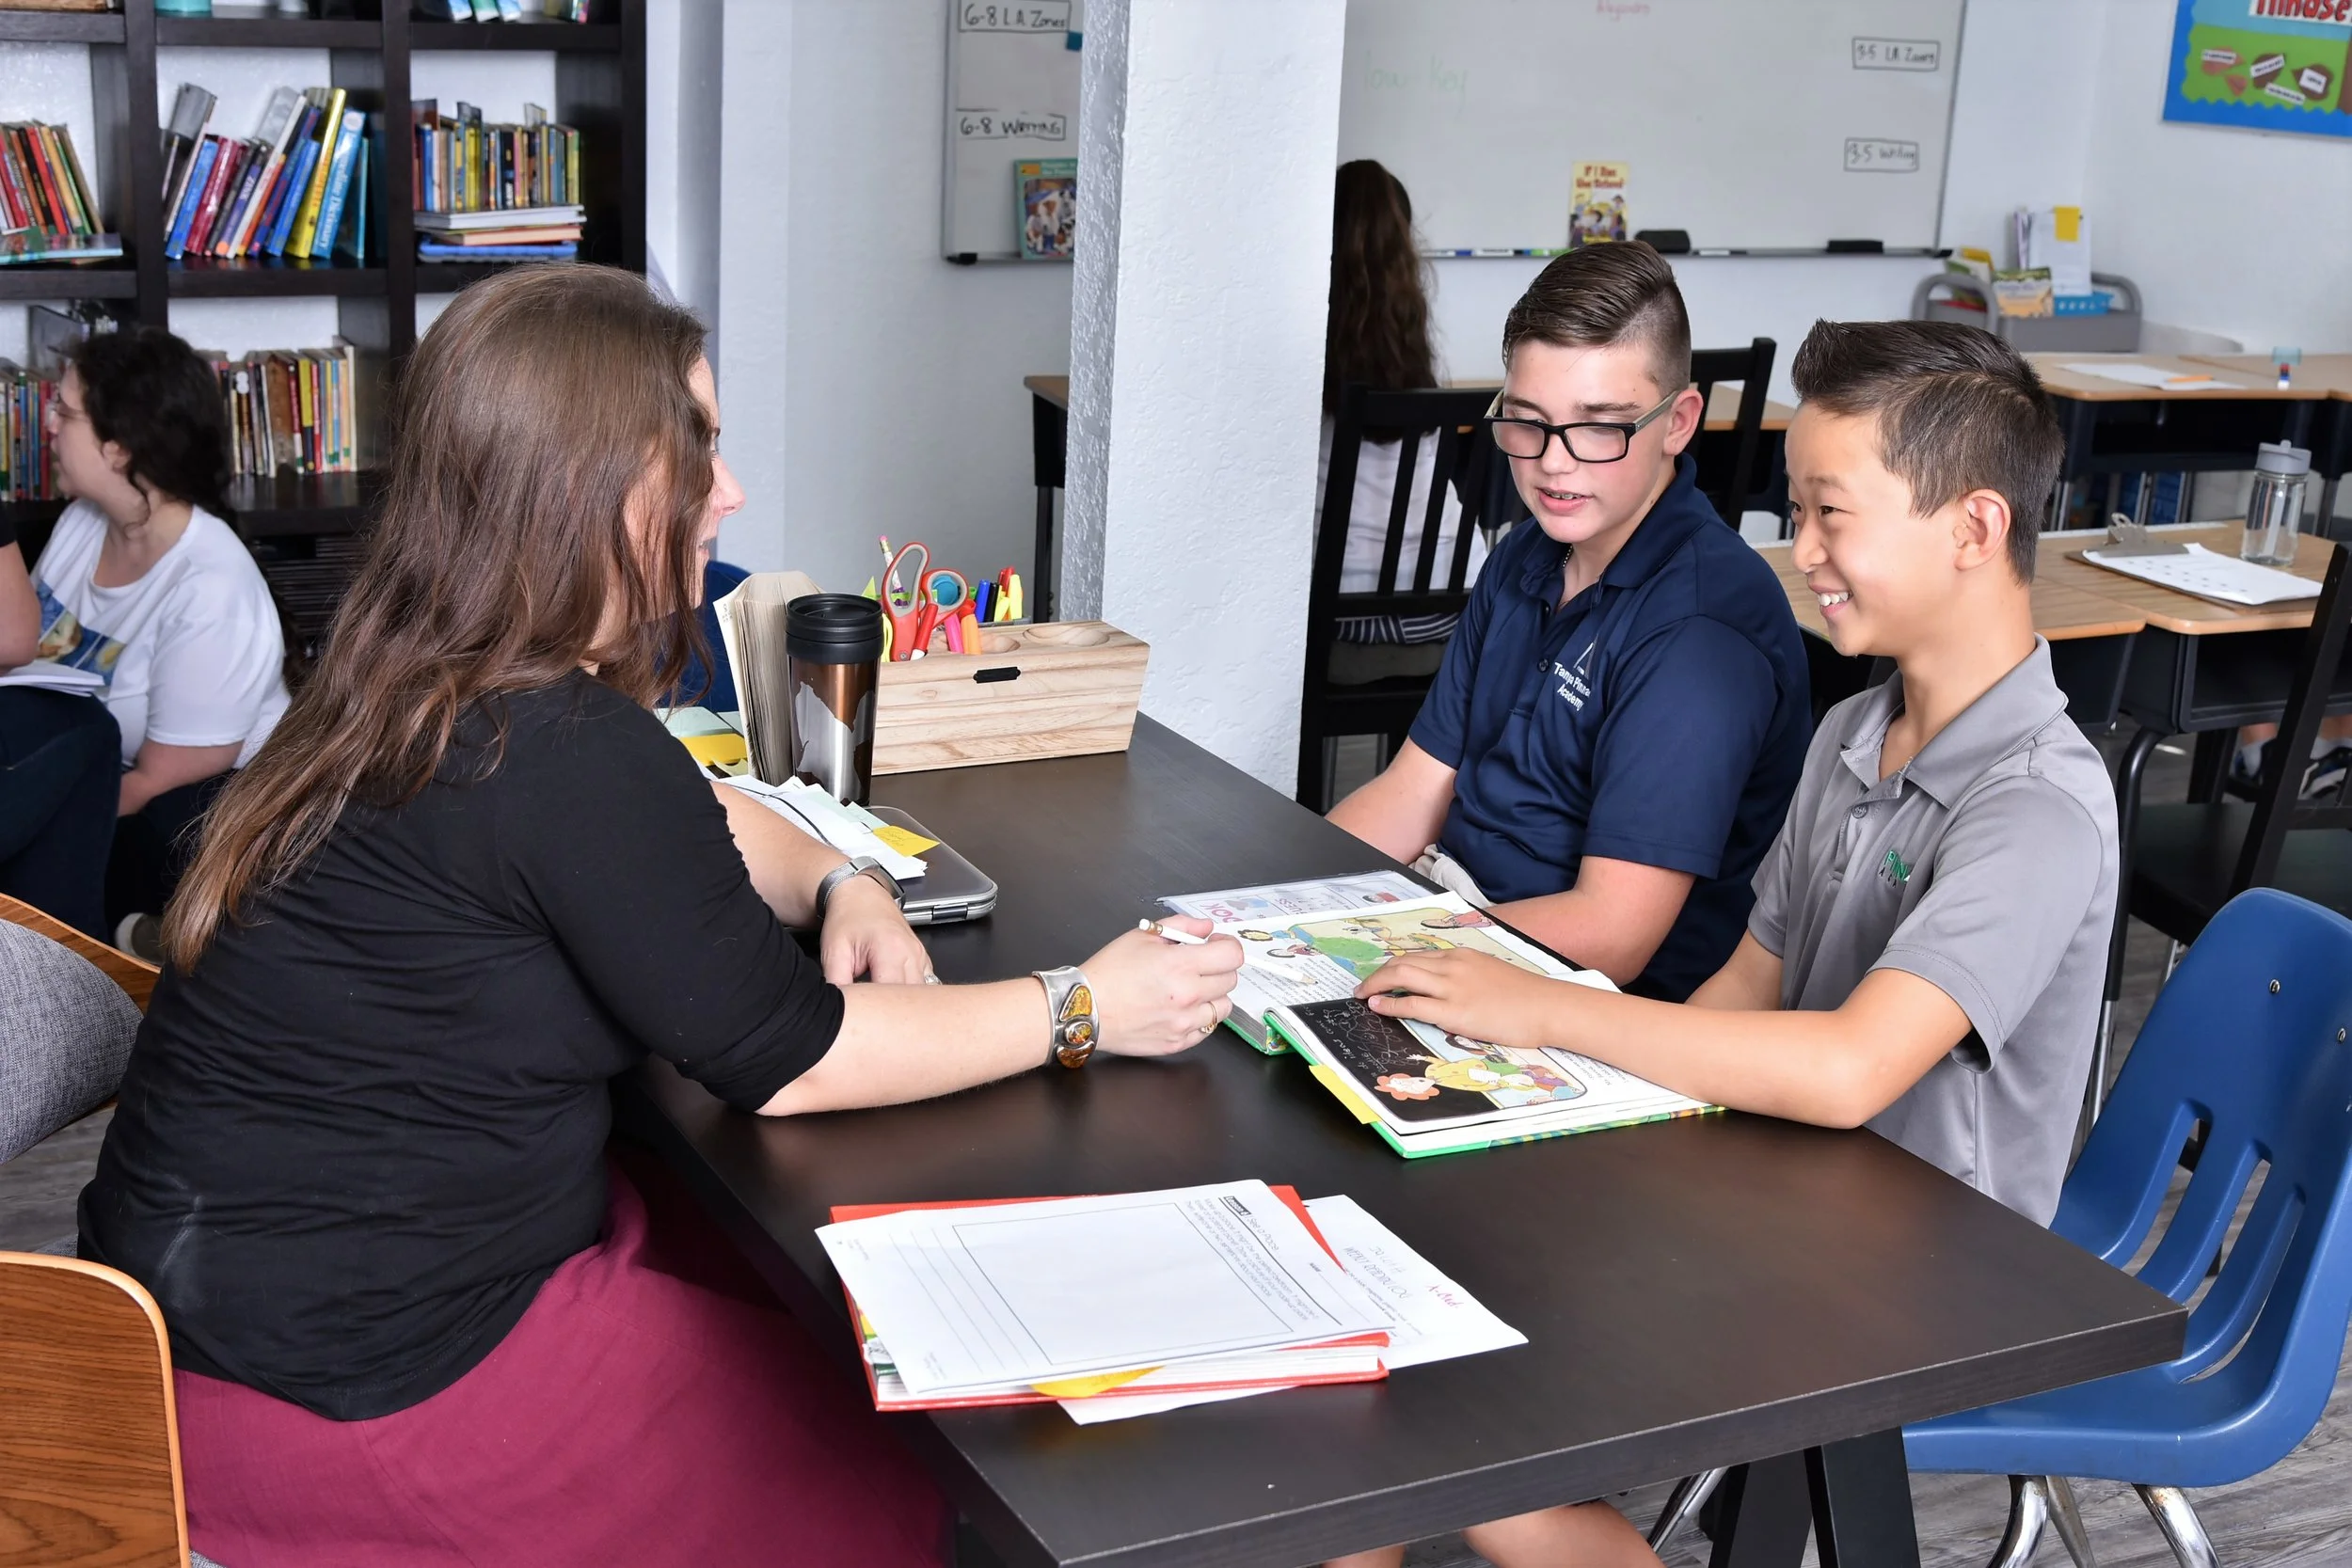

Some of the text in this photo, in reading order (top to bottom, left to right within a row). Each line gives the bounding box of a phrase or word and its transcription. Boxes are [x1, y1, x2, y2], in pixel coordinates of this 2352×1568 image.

[964, 3, 997, 27] 6-8
[960, 117, 993, 135] 6-8
[1554, 661, 1575, 685] Tampa
[1557, 683, 1584, 711] Academy
